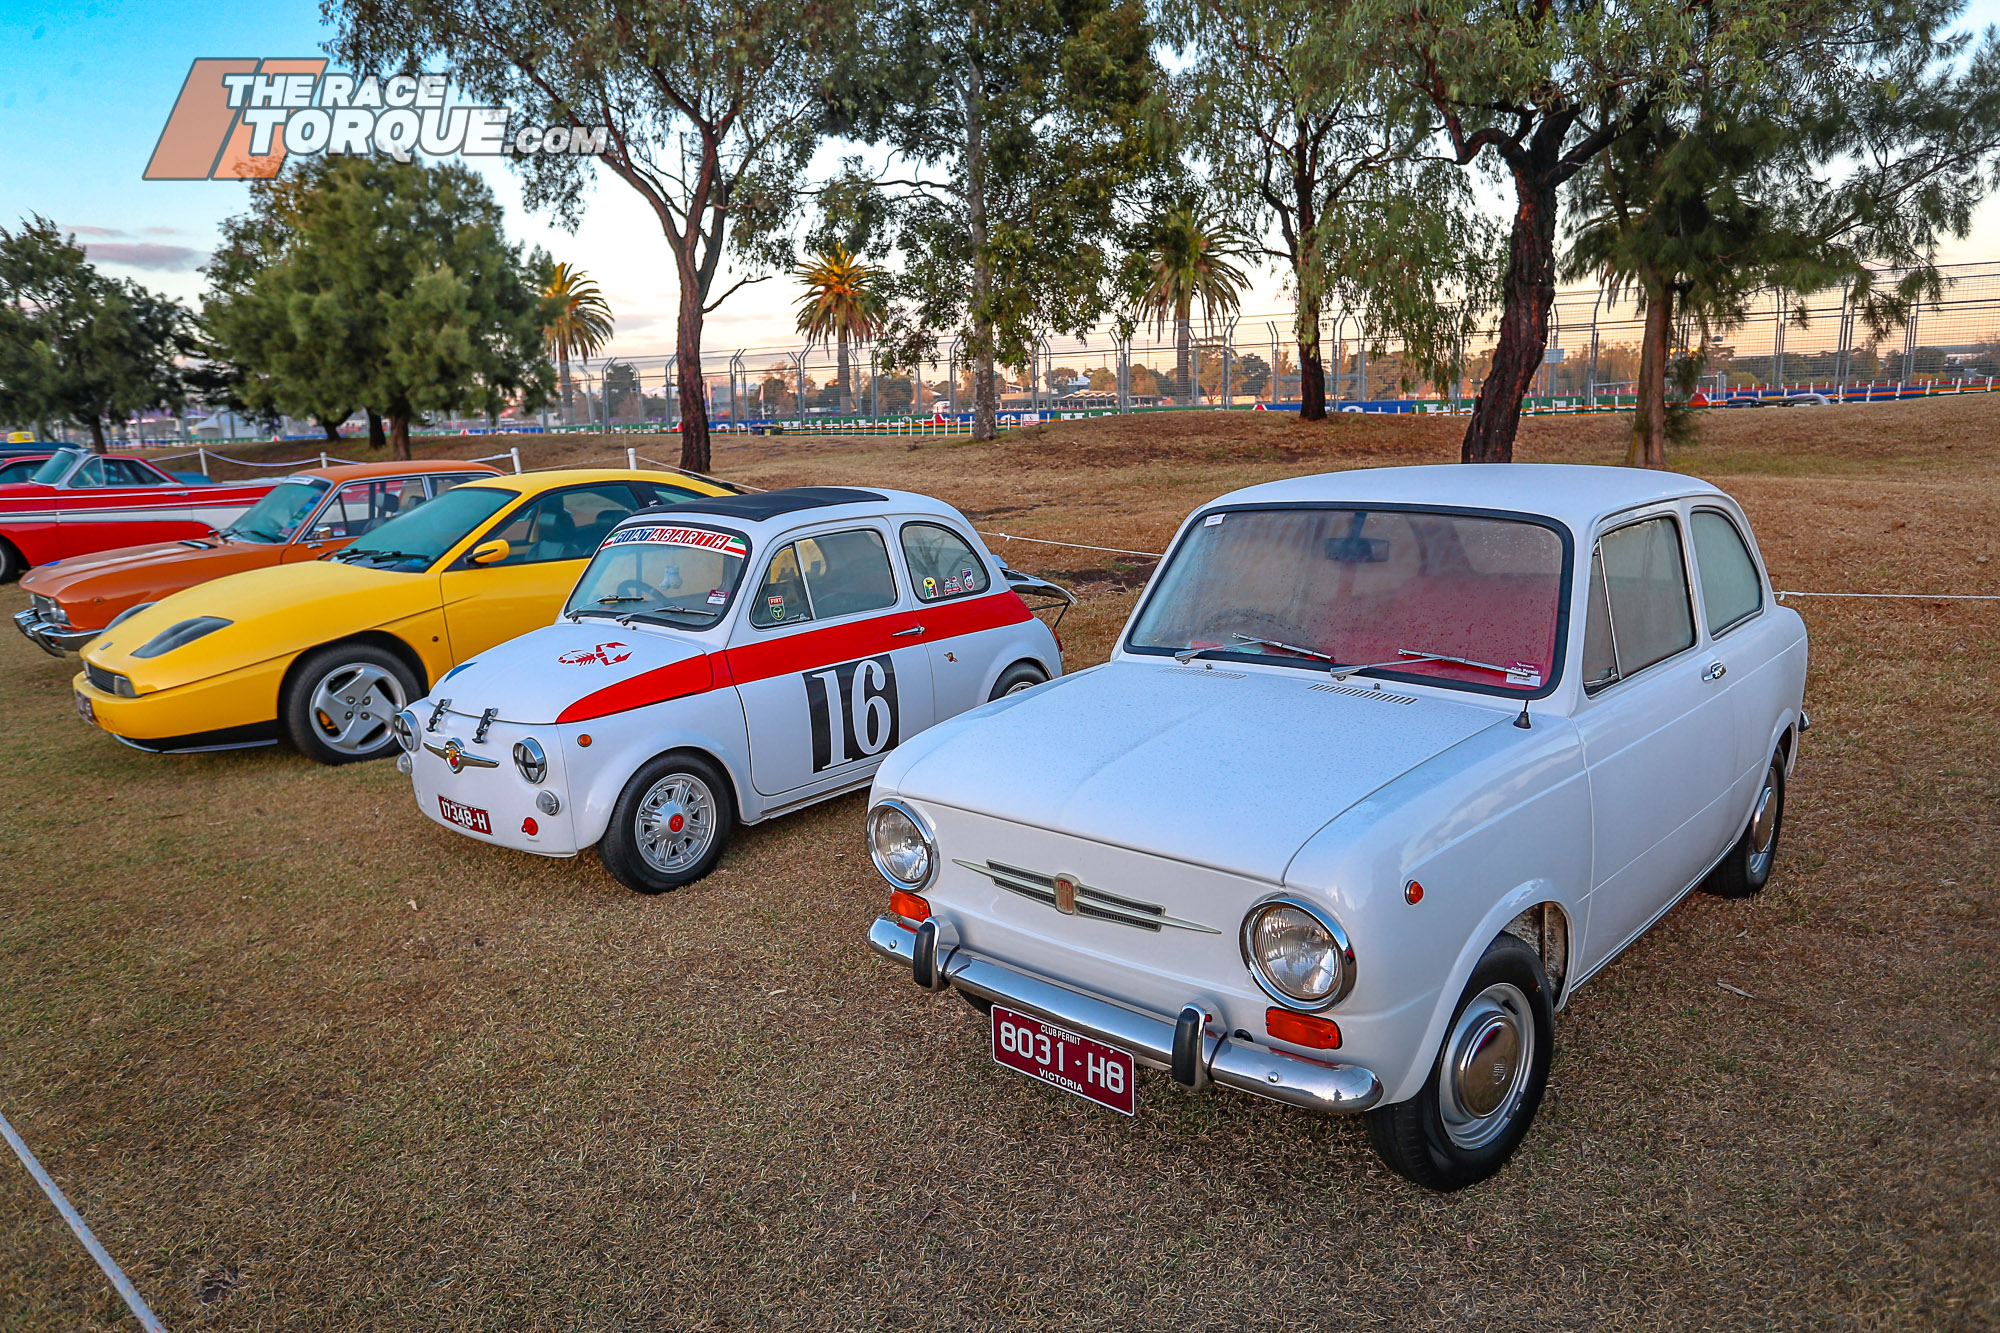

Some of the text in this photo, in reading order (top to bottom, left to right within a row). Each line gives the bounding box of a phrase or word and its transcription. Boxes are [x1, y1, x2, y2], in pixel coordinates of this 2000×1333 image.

[812, 659, 892, 770] 16
[1040, 1024, 1081, 1046] CLUB PERMIT
[1038, 1067, 1084, 1093] VICTORIA
